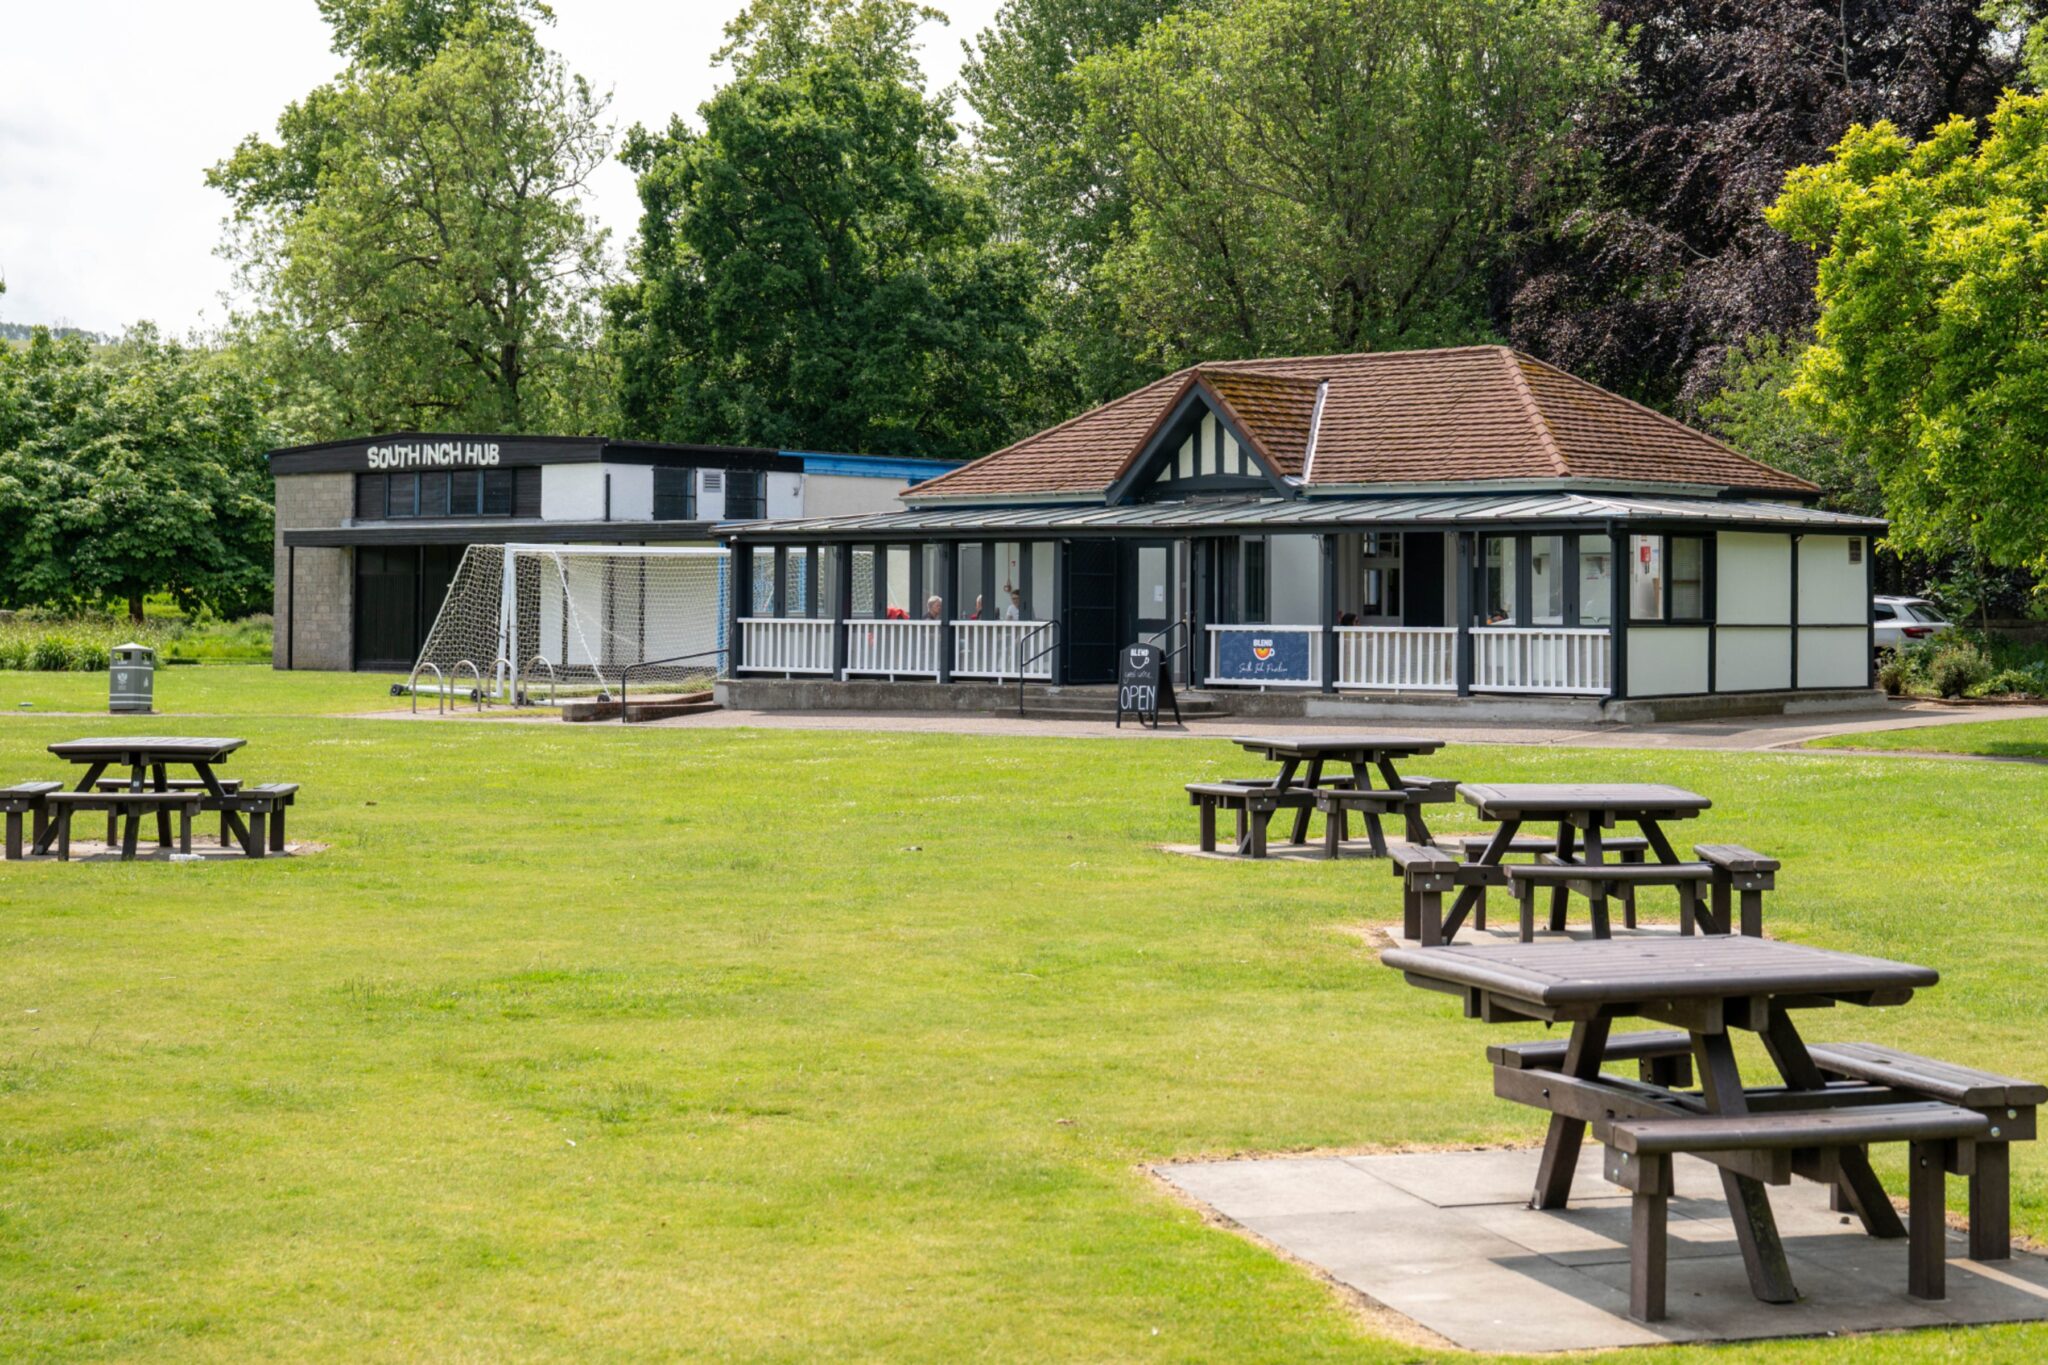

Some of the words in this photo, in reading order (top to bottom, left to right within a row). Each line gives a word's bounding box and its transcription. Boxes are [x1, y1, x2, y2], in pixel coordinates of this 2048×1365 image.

[367, 444, 420, 469] SOUTH
[422, 442, 462, 465] INCH
[464, 443, 500, 465] HUB
[1253, 639, 1273, 647] BLEND
[1130, 648, 1149, 656] BLEND
[1121, 685, 1155, 711] OPEN
